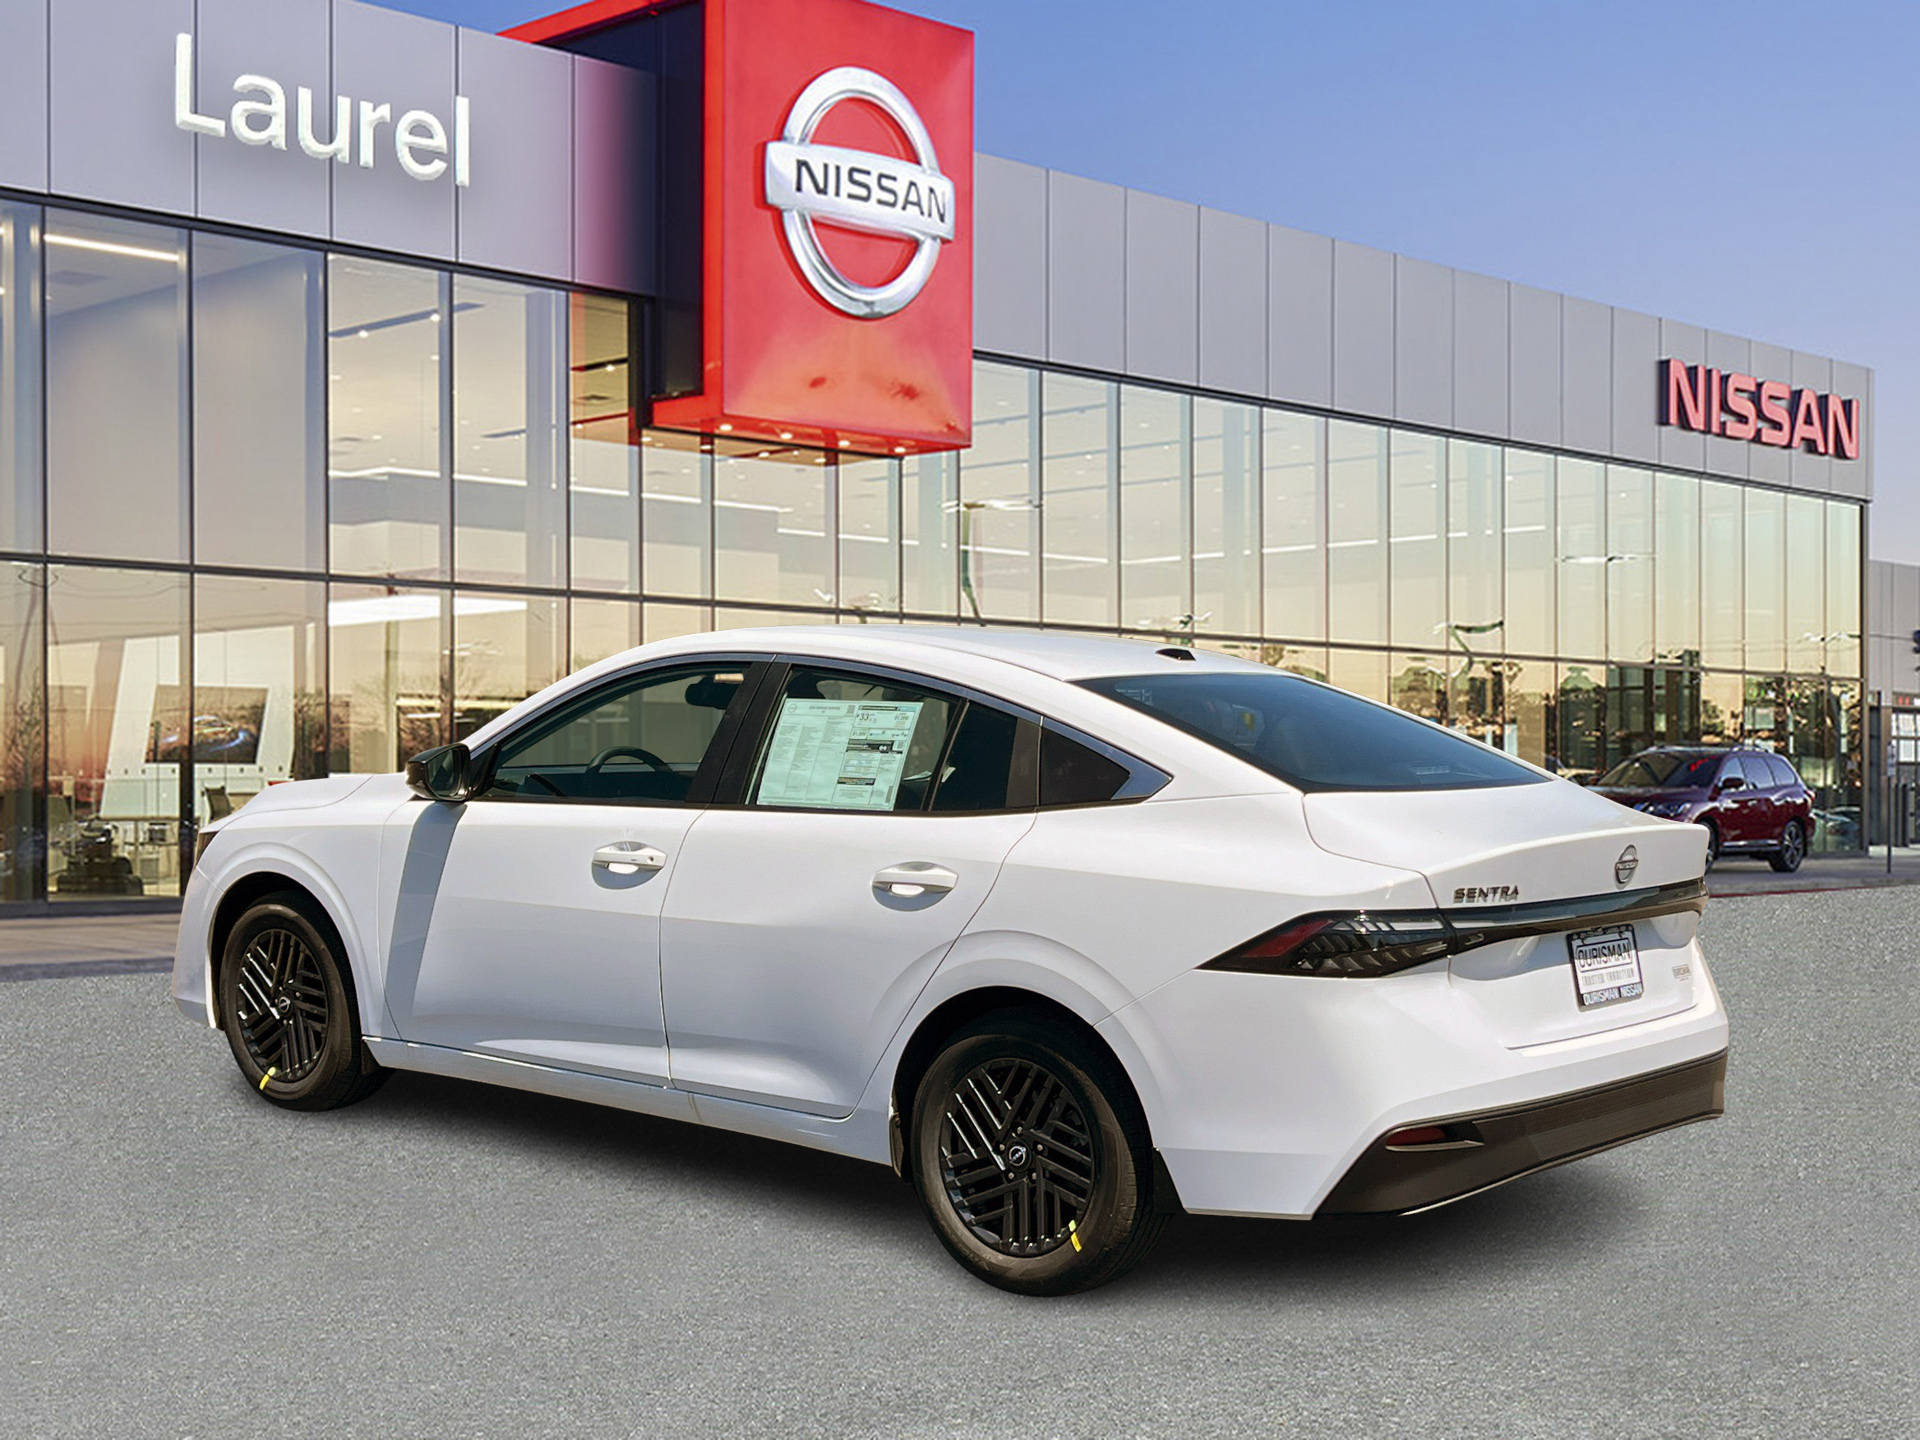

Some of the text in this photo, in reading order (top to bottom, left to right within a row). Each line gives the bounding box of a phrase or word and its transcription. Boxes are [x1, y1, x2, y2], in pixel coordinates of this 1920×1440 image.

[174, 32, 470, 187] Laurel
[794, 158, 947, 224] NISSAN
[1658, 358, 1859, 460] NISSAN
[1453, 885, 1519, 902] SENTRA
[1577, 943, 1632, 968] OURISMAN
